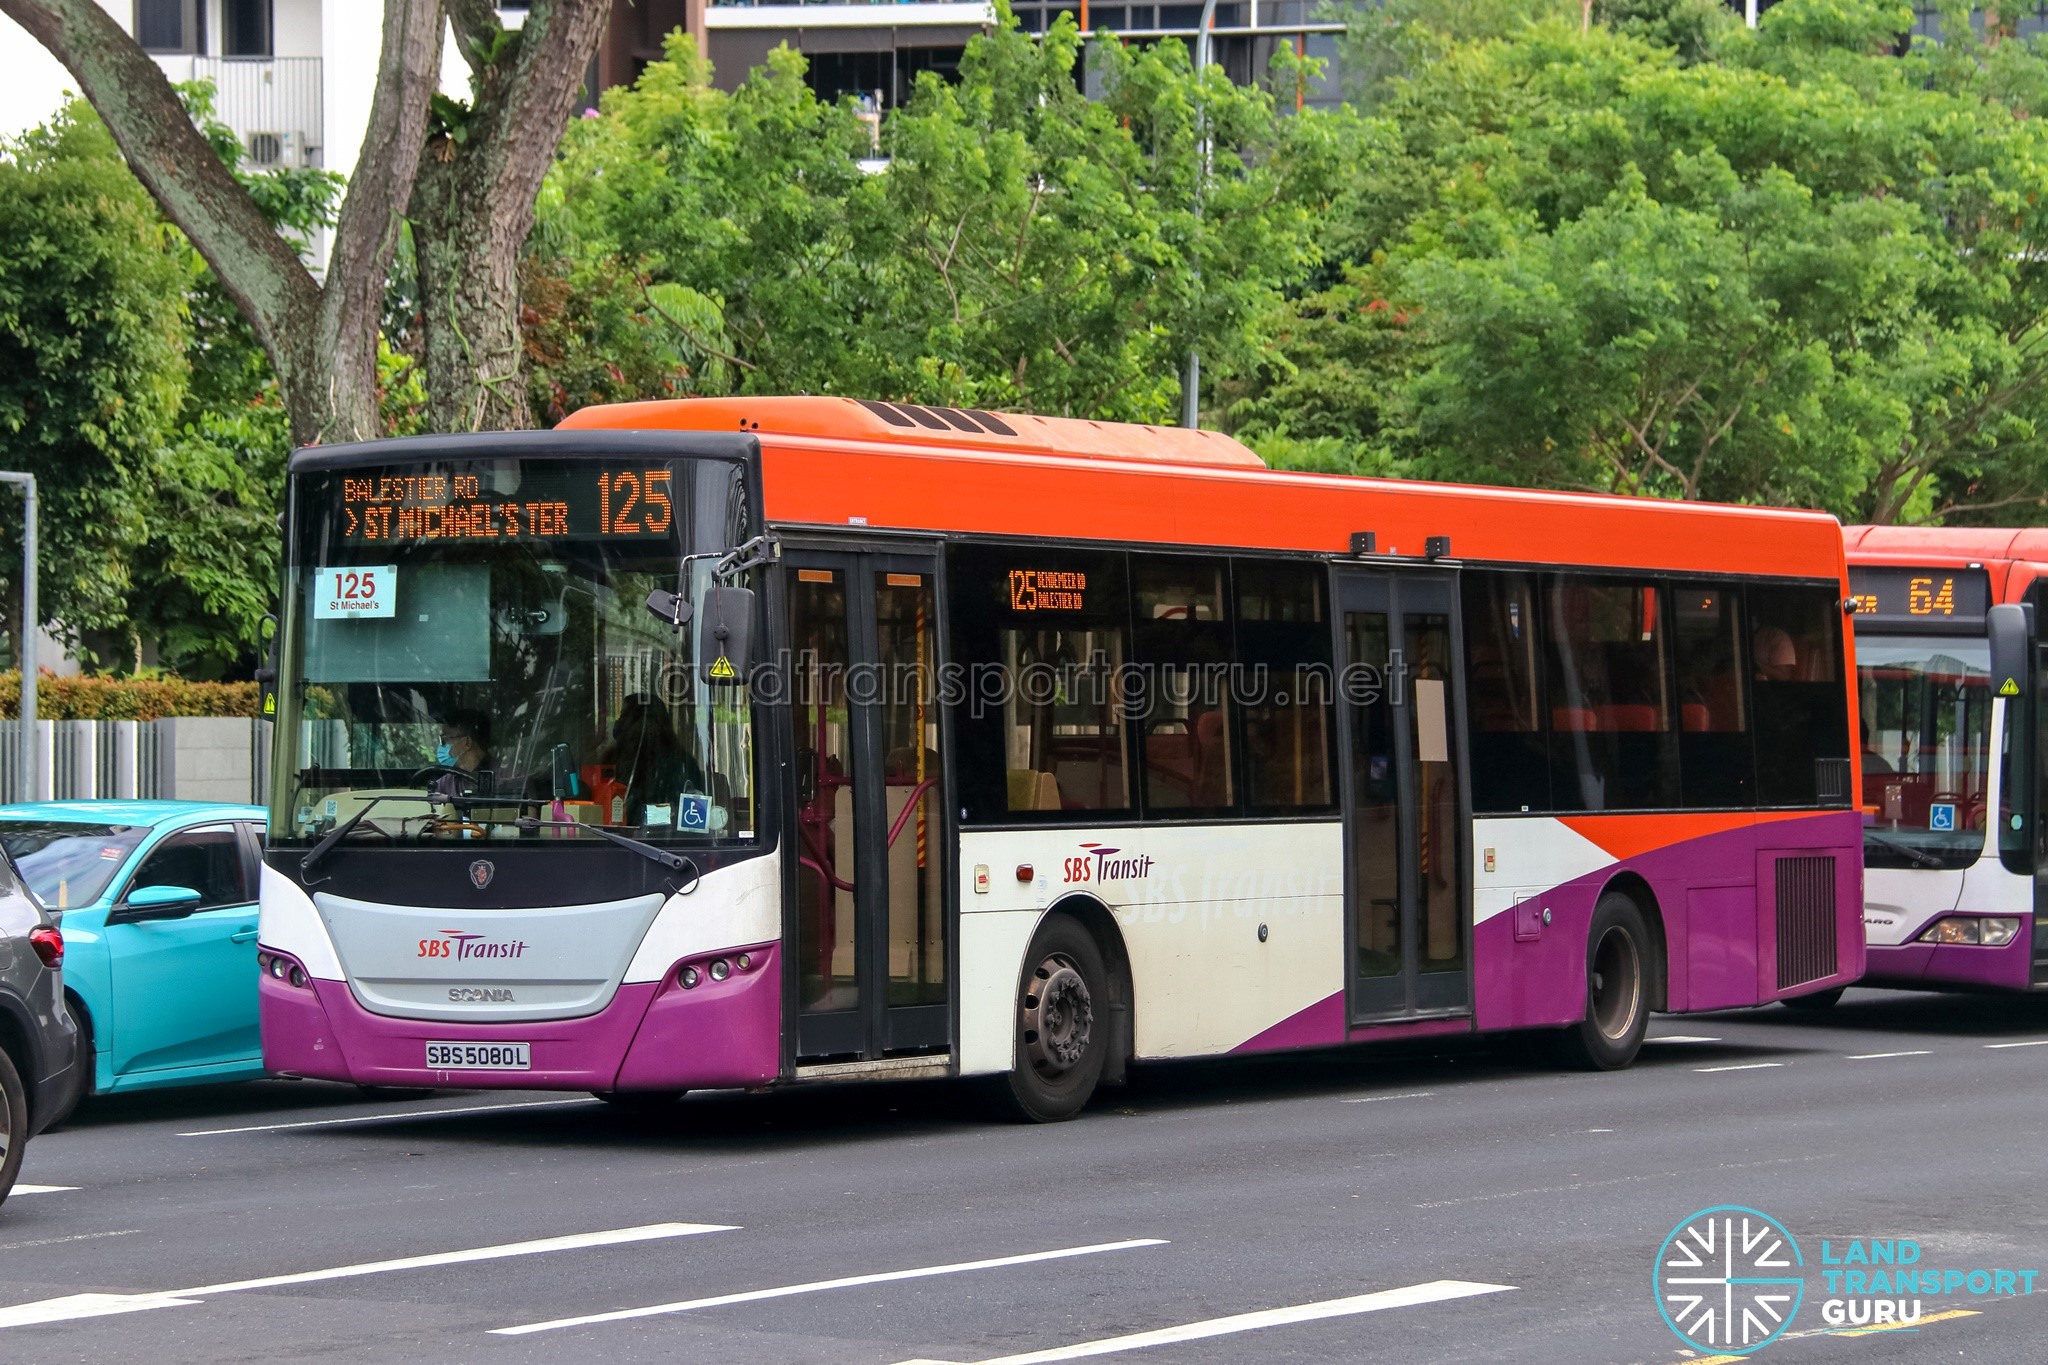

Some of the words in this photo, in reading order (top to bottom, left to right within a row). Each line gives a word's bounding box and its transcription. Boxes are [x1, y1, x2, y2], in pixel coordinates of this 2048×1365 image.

[344, 477, 446, 502] BALESTIER
[454, 475, 479, 500] RD
[597, 470, 671, 534] 125
[364, 506, 392, 539] ST
[398, 502, 519, 538] MICHAEL'S
[526, 501, 568, 536] TER
[335, 572, 376, 599] 125
[1008, 570, 1037, 610] 125
[1909, 578, 1955, 615] 64
[330, 601, 339, 611] St
[340, 600, 380, 611] Michael's
[1063, 856, 1091, 883] SBS
[1089, 848, 1156, 886] Transit
[417, 939, 451, 958] SBS
[448, 935, 531, 963] Transit
[448, 988, 515, 1002] SCANIA
[428, 1046, 528, 1066] SBS5080L
